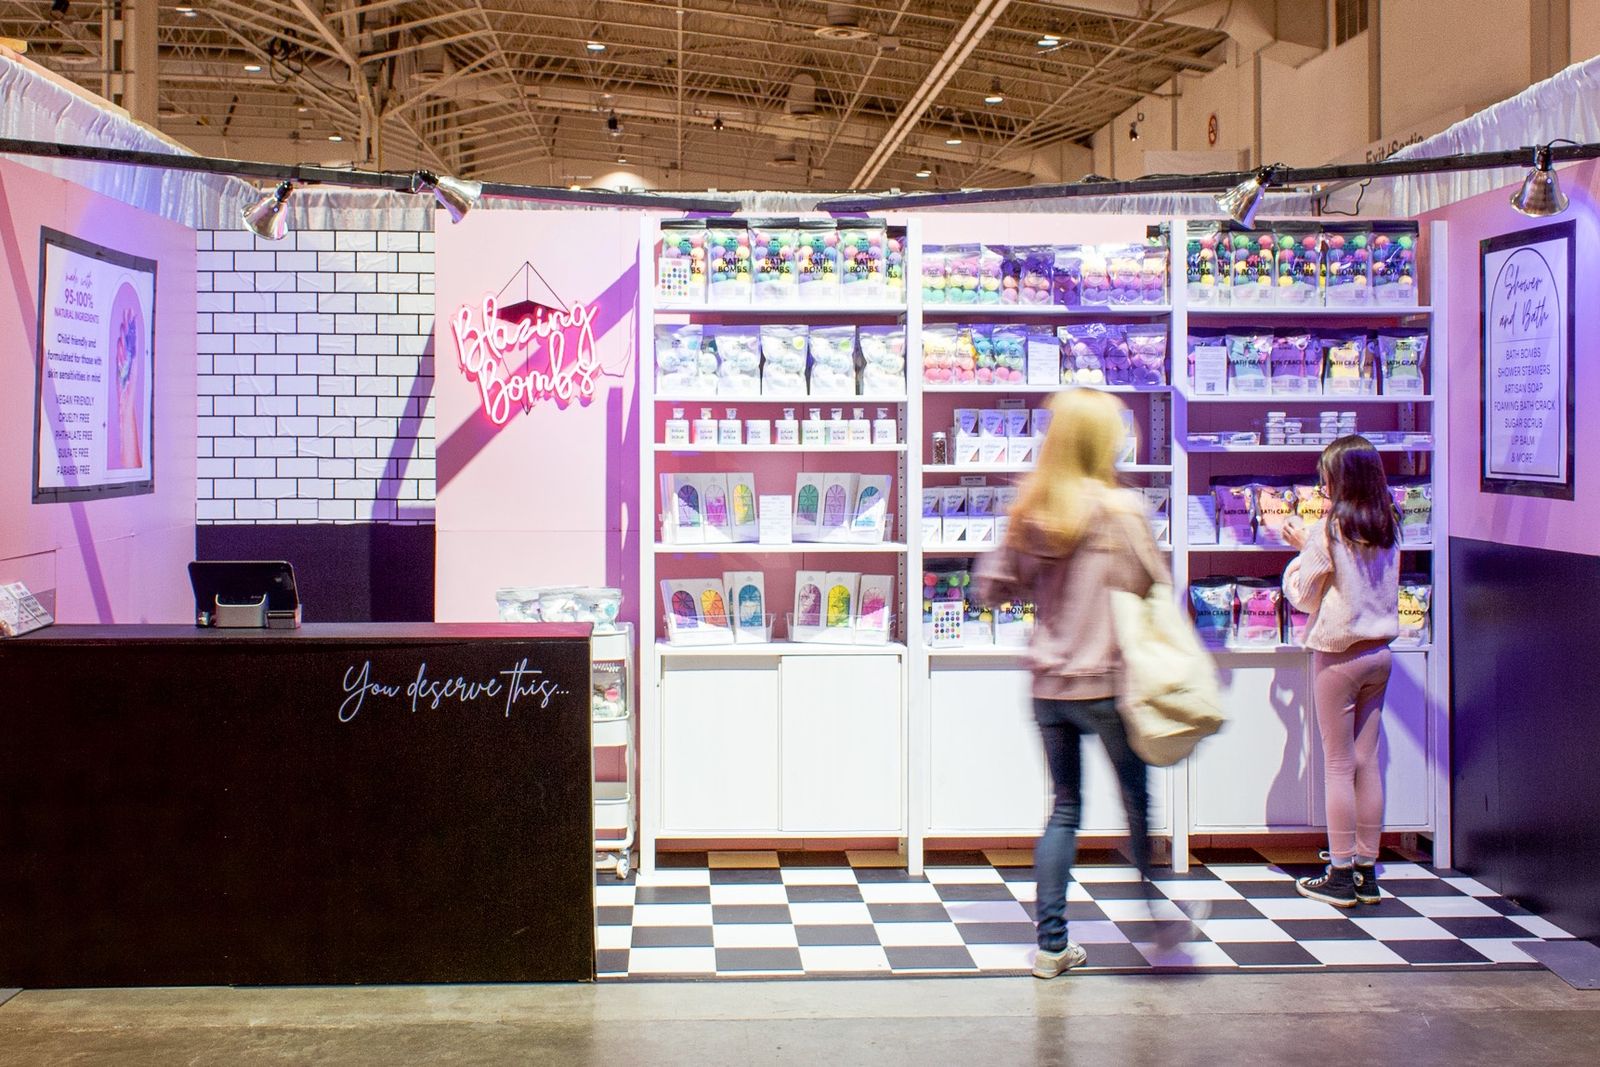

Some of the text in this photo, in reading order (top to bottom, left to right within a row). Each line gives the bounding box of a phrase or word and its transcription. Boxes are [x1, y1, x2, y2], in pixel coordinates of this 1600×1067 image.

[64, 288, 94, 309] 95-100%
[1504, 263, 1543, 300] Shower
[453, 295, 598, 372] Blazing
[1521, 295, 1550, 332] Bath
[477, 330, 598, 424] Bombs
[338, 660, 400, 722] You
[407, 663, 502, 712] deserve
